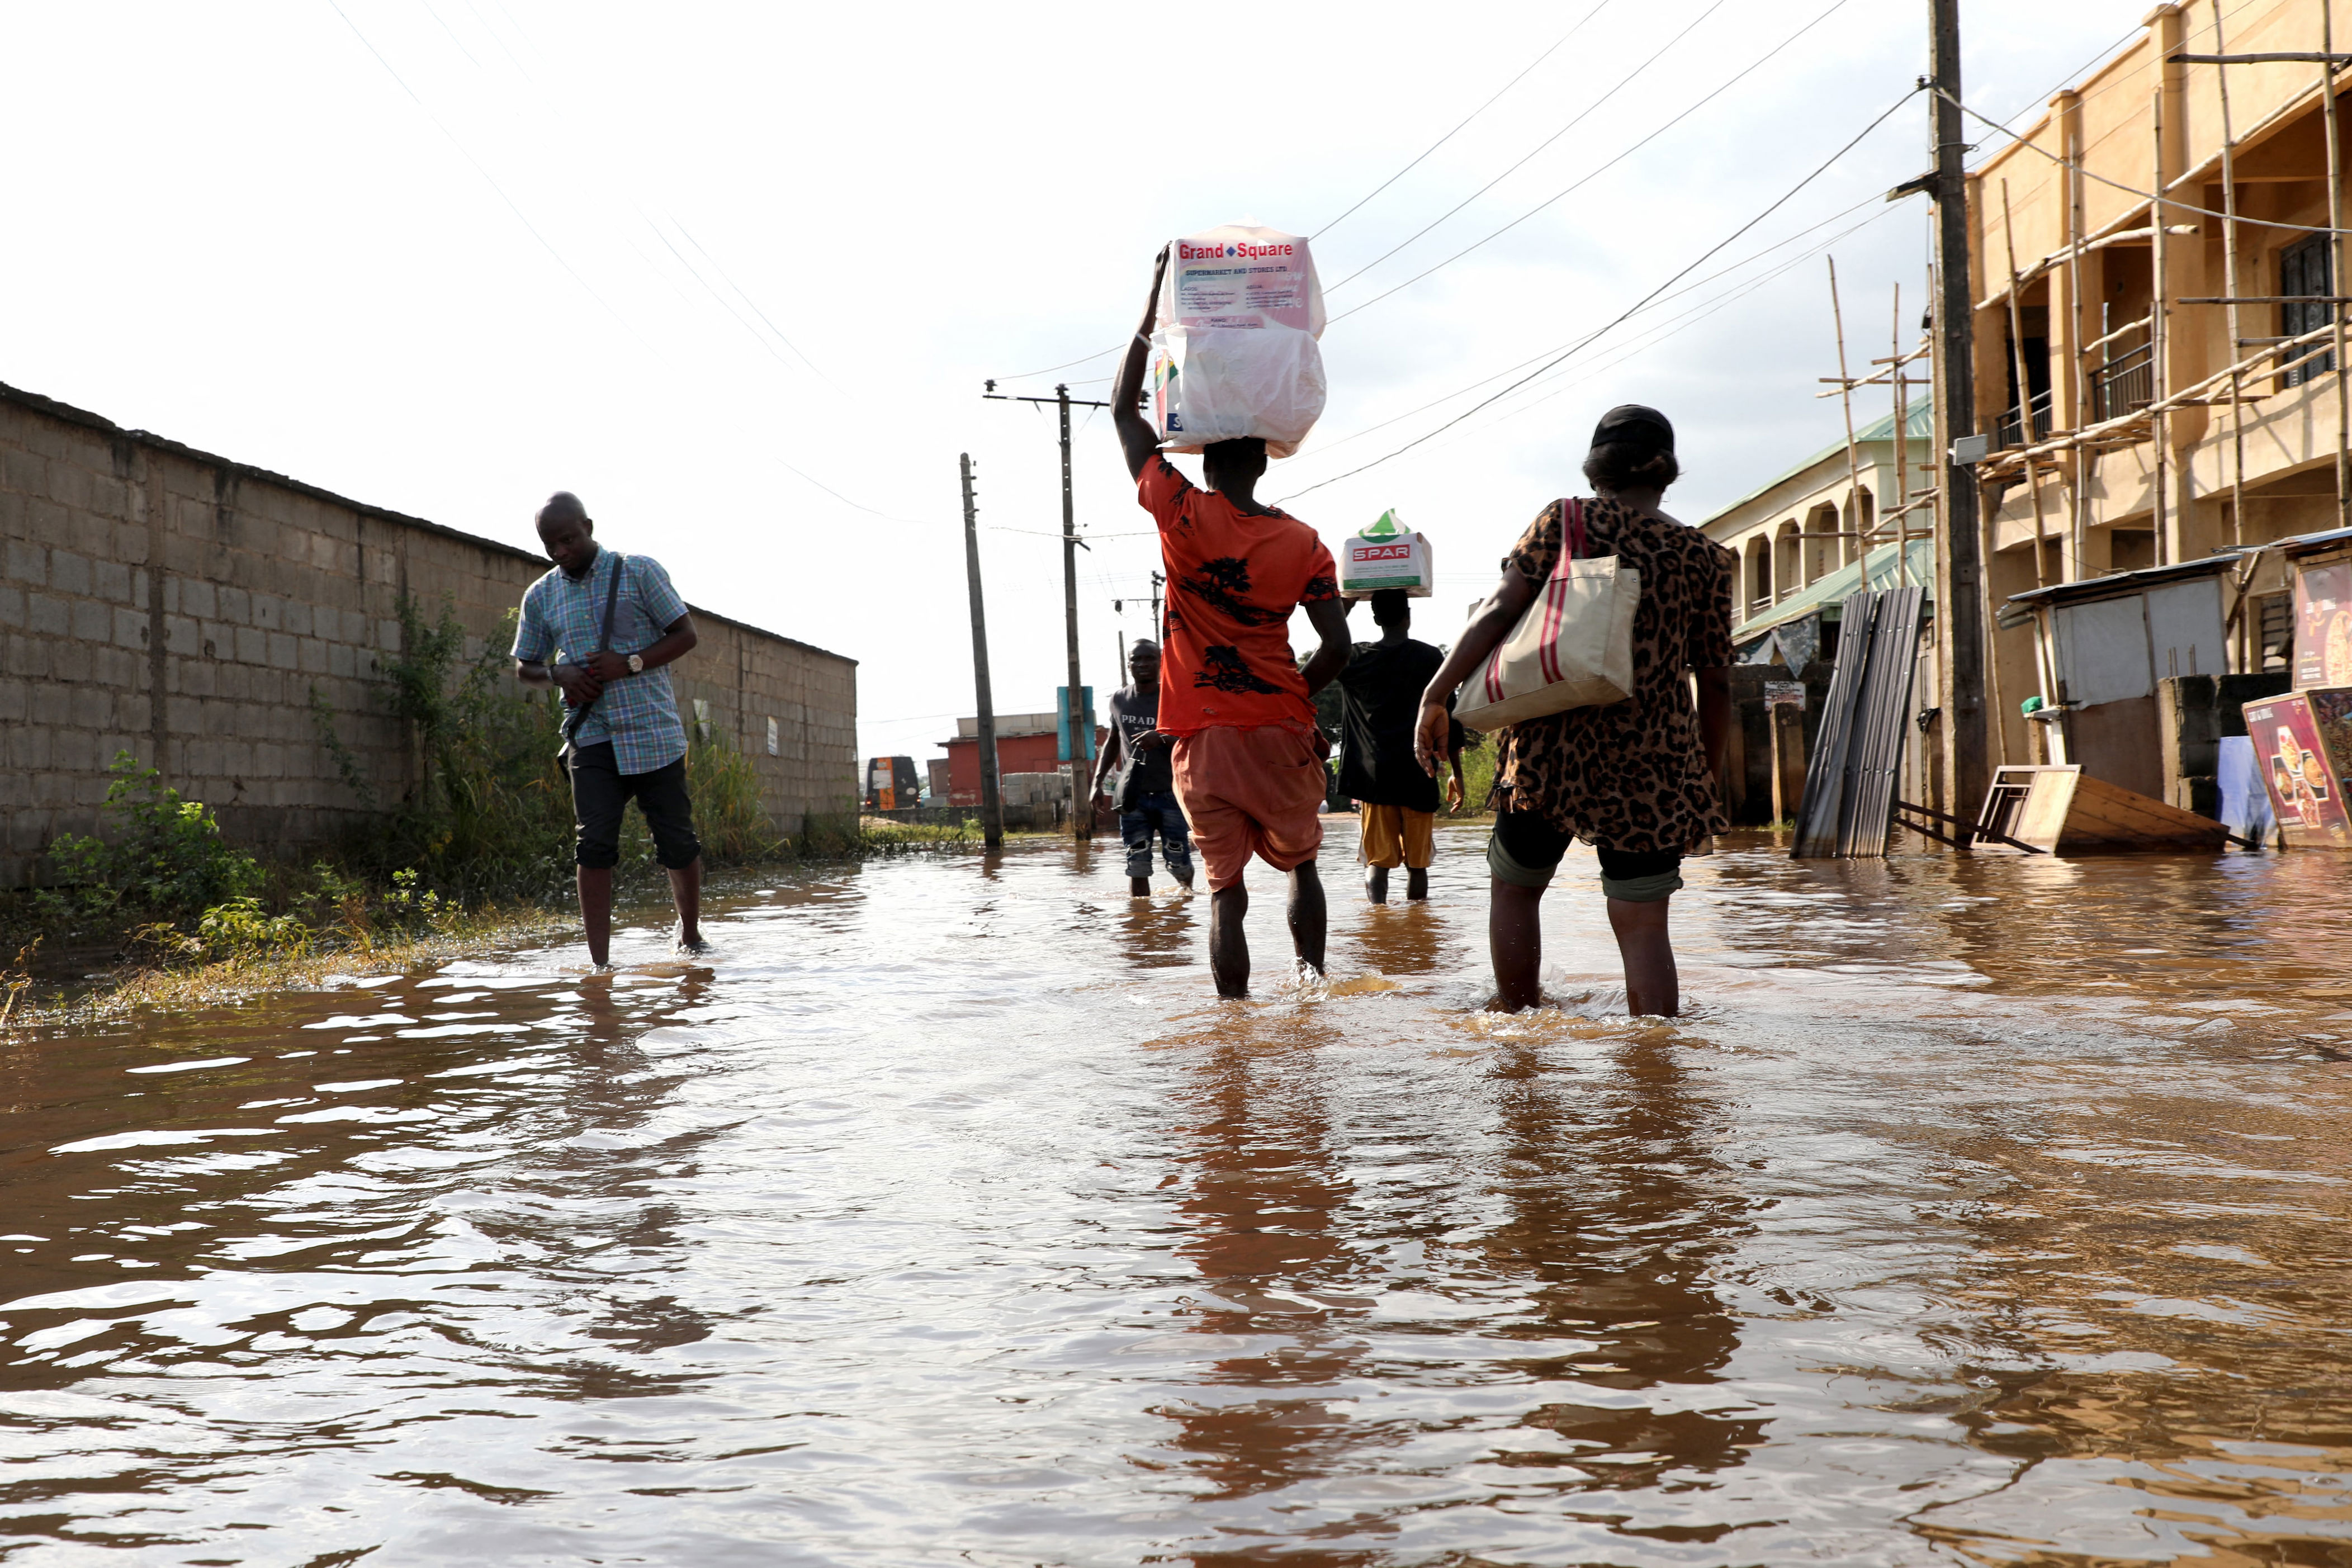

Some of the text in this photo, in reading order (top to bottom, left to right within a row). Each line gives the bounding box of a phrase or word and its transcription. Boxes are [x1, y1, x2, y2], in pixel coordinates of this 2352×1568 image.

[1180, 243, 1293, 260] Grand Square
[1354, 547, 1408, 560] SPAR
[1121, 714, 1156, 726] PRAD
